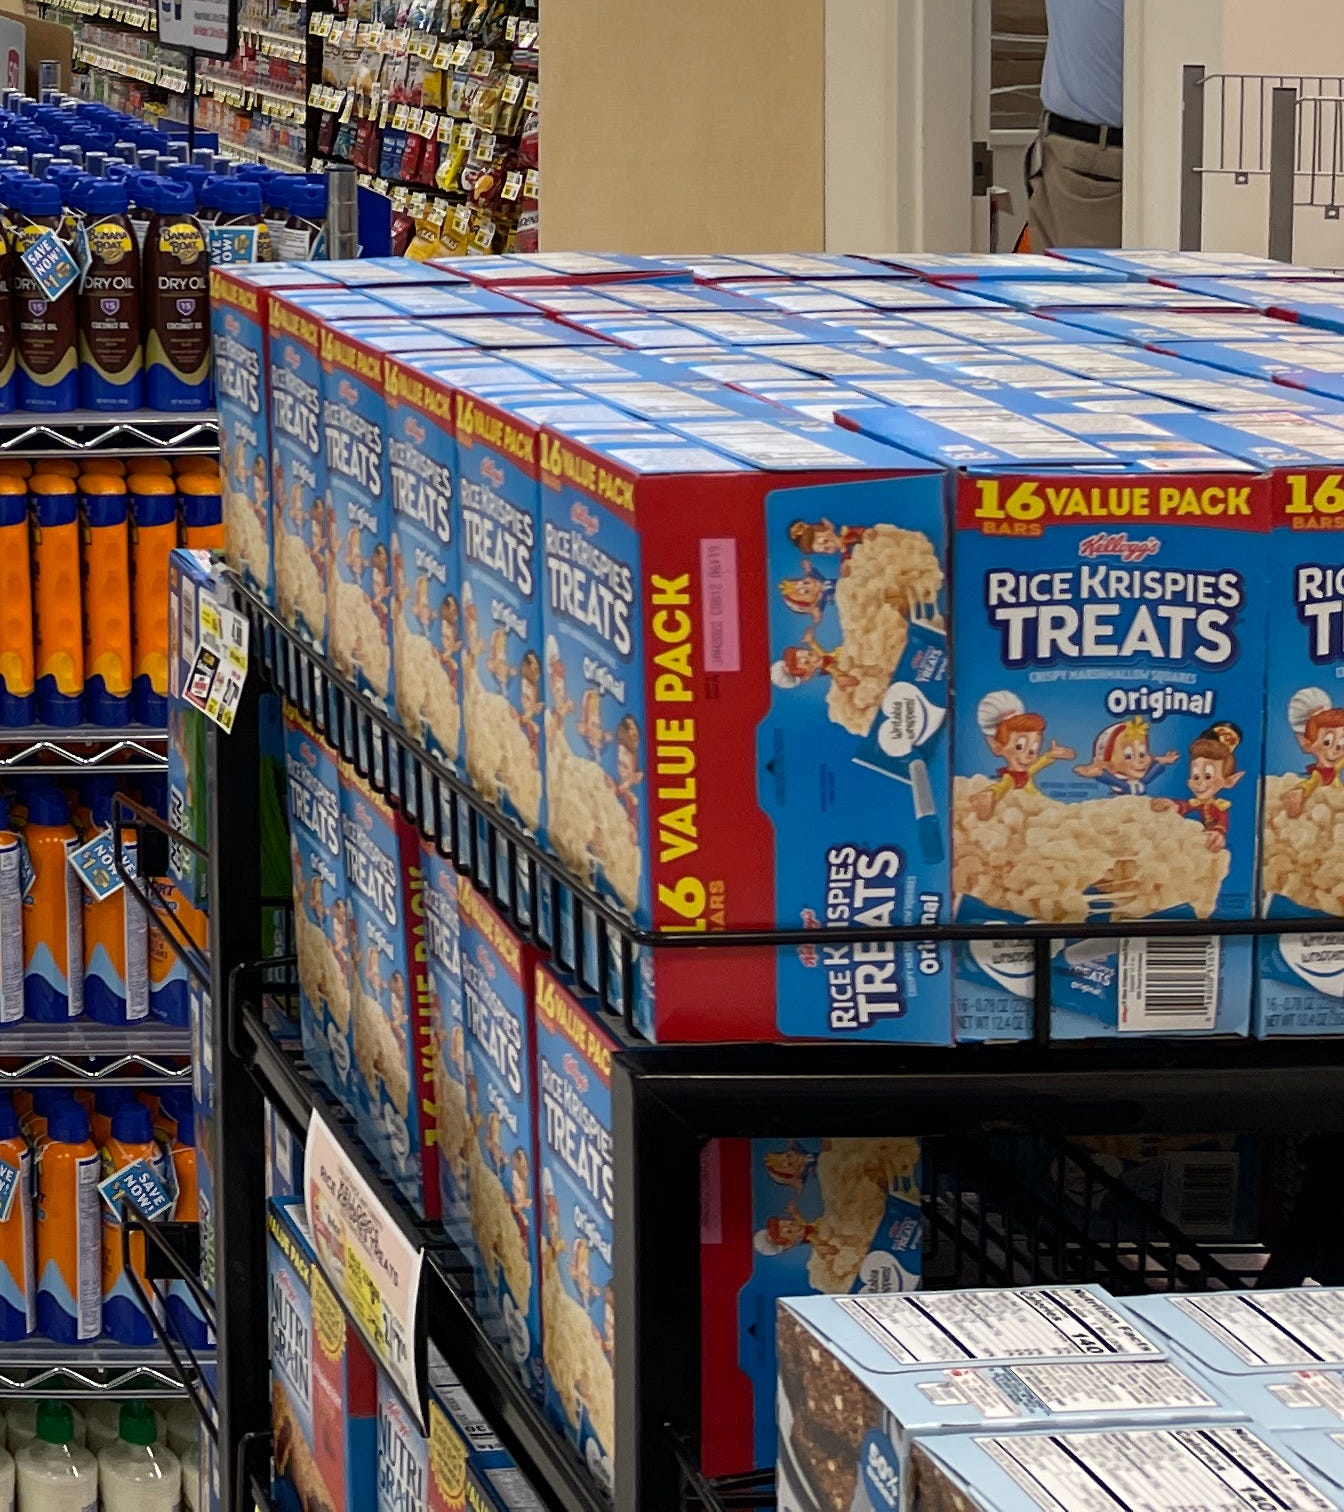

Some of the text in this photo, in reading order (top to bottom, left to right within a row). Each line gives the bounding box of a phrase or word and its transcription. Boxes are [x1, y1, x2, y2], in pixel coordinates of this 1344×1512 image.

[26, 239, 51, 265] SAVE
[162, 229, 207, 242] BANANA
[169, 239, 200, 252] BOAT
[35, 248, 60, 276] NOW!
[85, 276, 113, 290] DRY
[158, 276, 187, 290] DRY
[216, 356, 259, 413] TREATS
[272, 389, 320, 454] TREATS
[325, 427, 382, 496] TREATS
[391, 467, 451, 544] TREATS
[974, 474, 1344, 521] 16 VALUE PACK 16
[983, 520, 1043, 536] BARS
[1078, 532, 1161, 561] Kellogg's
[463, 510, 533, 596] TREATS
[547, 557, 632, 655] TREATS
[989, 565, 1241, 608] RICE KRISPIES
[995, 603, 1234, 665] TREATS
[651, 573, 699, 864] VALUE PACK
[1107, 687, 1214, 719] Original
[346, 847, 396, 929] TREATS
[854, 849, 902, 1024] TREATS
[830, 968, 857, 1031] RICE
[464, 983, 521, 1095] TREATS
[123, 1174, 154, 1214] NOW!
[139, 1172, 165, 1206] SAVE
[1072, 1333, 1104, 1354] 140
